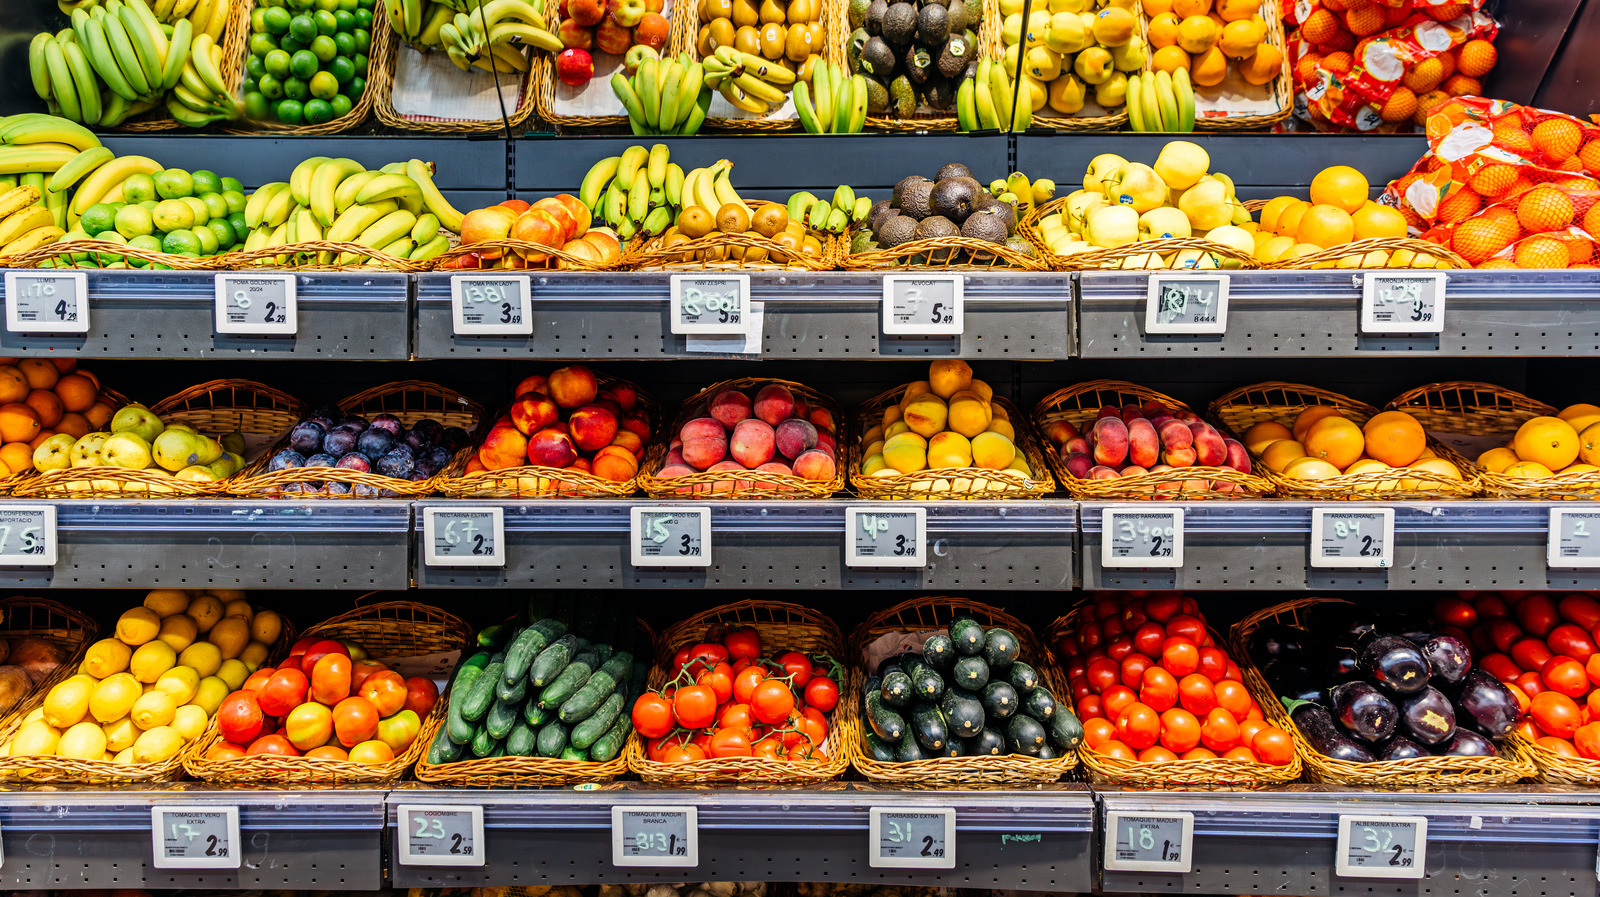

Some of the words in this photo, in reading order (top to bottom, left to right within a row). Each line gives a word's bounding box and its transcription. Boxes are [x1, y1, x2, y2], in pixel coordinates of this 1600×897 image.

[444, 519, 479, 544] 67
[1334, 520, 1360, 538] 84
[171, 823, 201, 842] 17
[413, 817, 446, 840] 23
[888, 821, 912, 843] 31
[1129, 827, 1155, 850] 18
